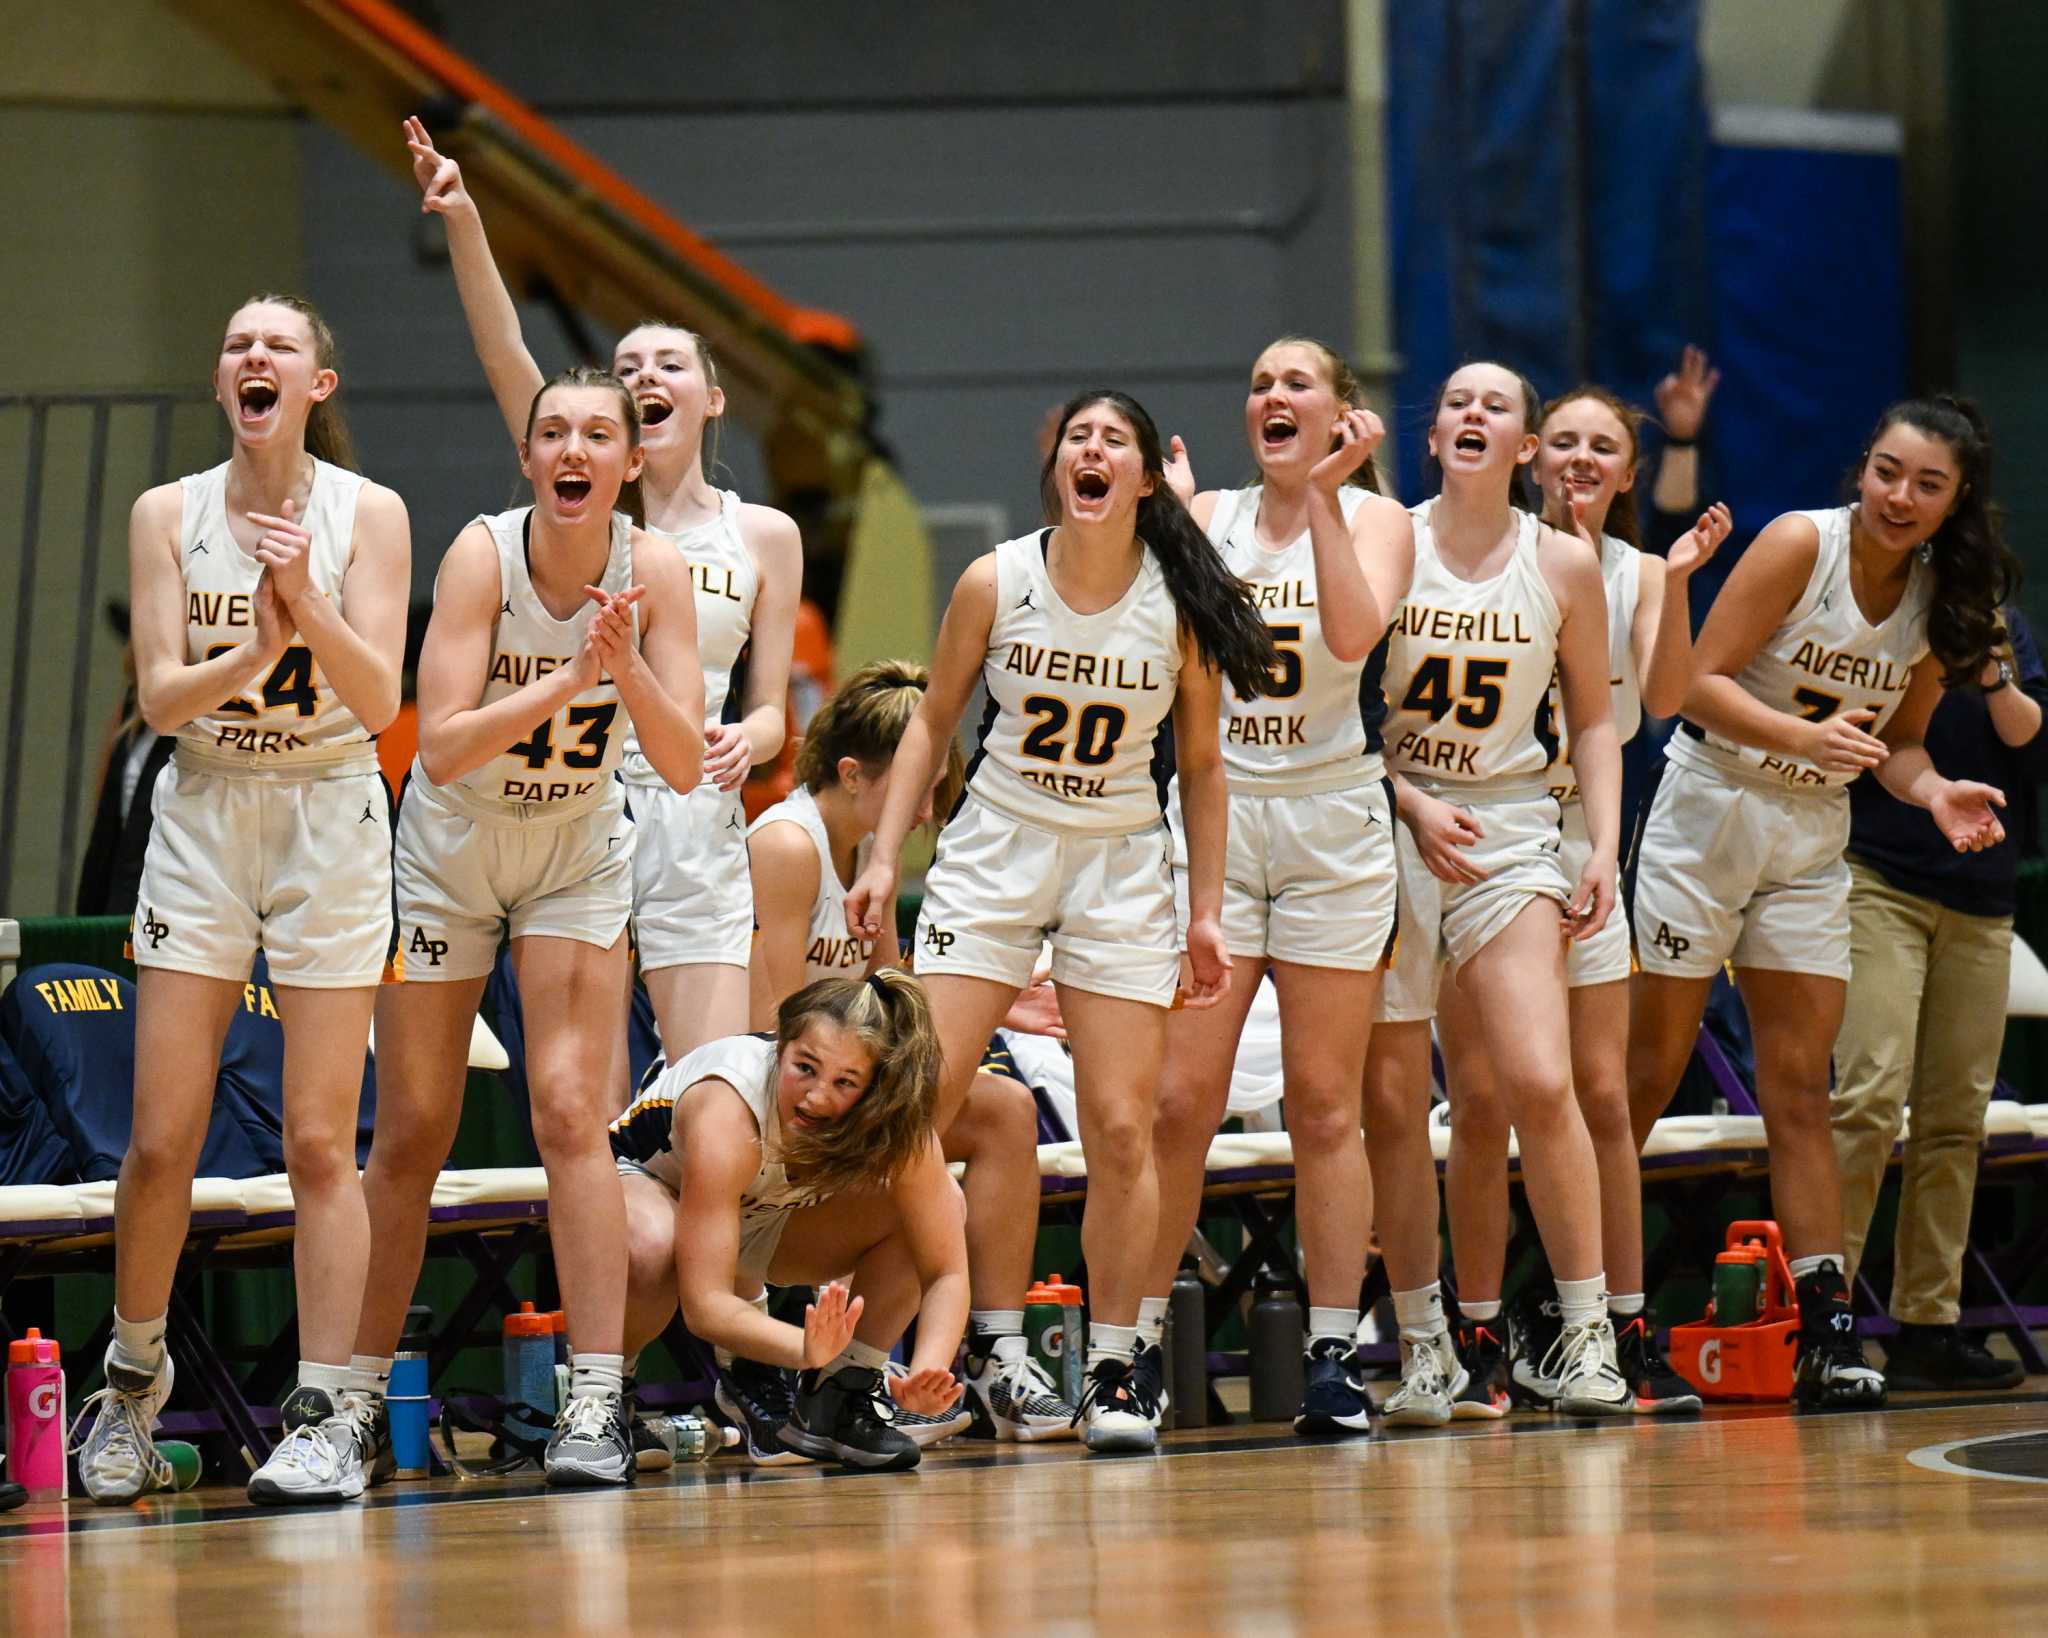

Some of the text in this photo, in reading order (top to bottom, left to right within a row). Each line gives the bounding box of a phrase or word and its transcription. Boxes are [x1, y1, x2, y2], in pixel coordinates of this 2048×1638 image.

[1396, 604, 1533, 643] AVERILL
[1005, 642, 1160, 692] AVERILL
[1400, 655, 1511, 730] 45
[505, 699, 619, 771] 43
[1020, 692, 1129, 767] 20
[1226, 715, 1307, 746] PARK
[1396, 730, 1481, 776] PARK
[503, 779, 597, 802] PARK
[410, 926, 449, 966] AP
[924, 922, 956, 956] AP
[1653, 921, 1690, 961] AP
[34, 978, 124, 1014] FAMILY
